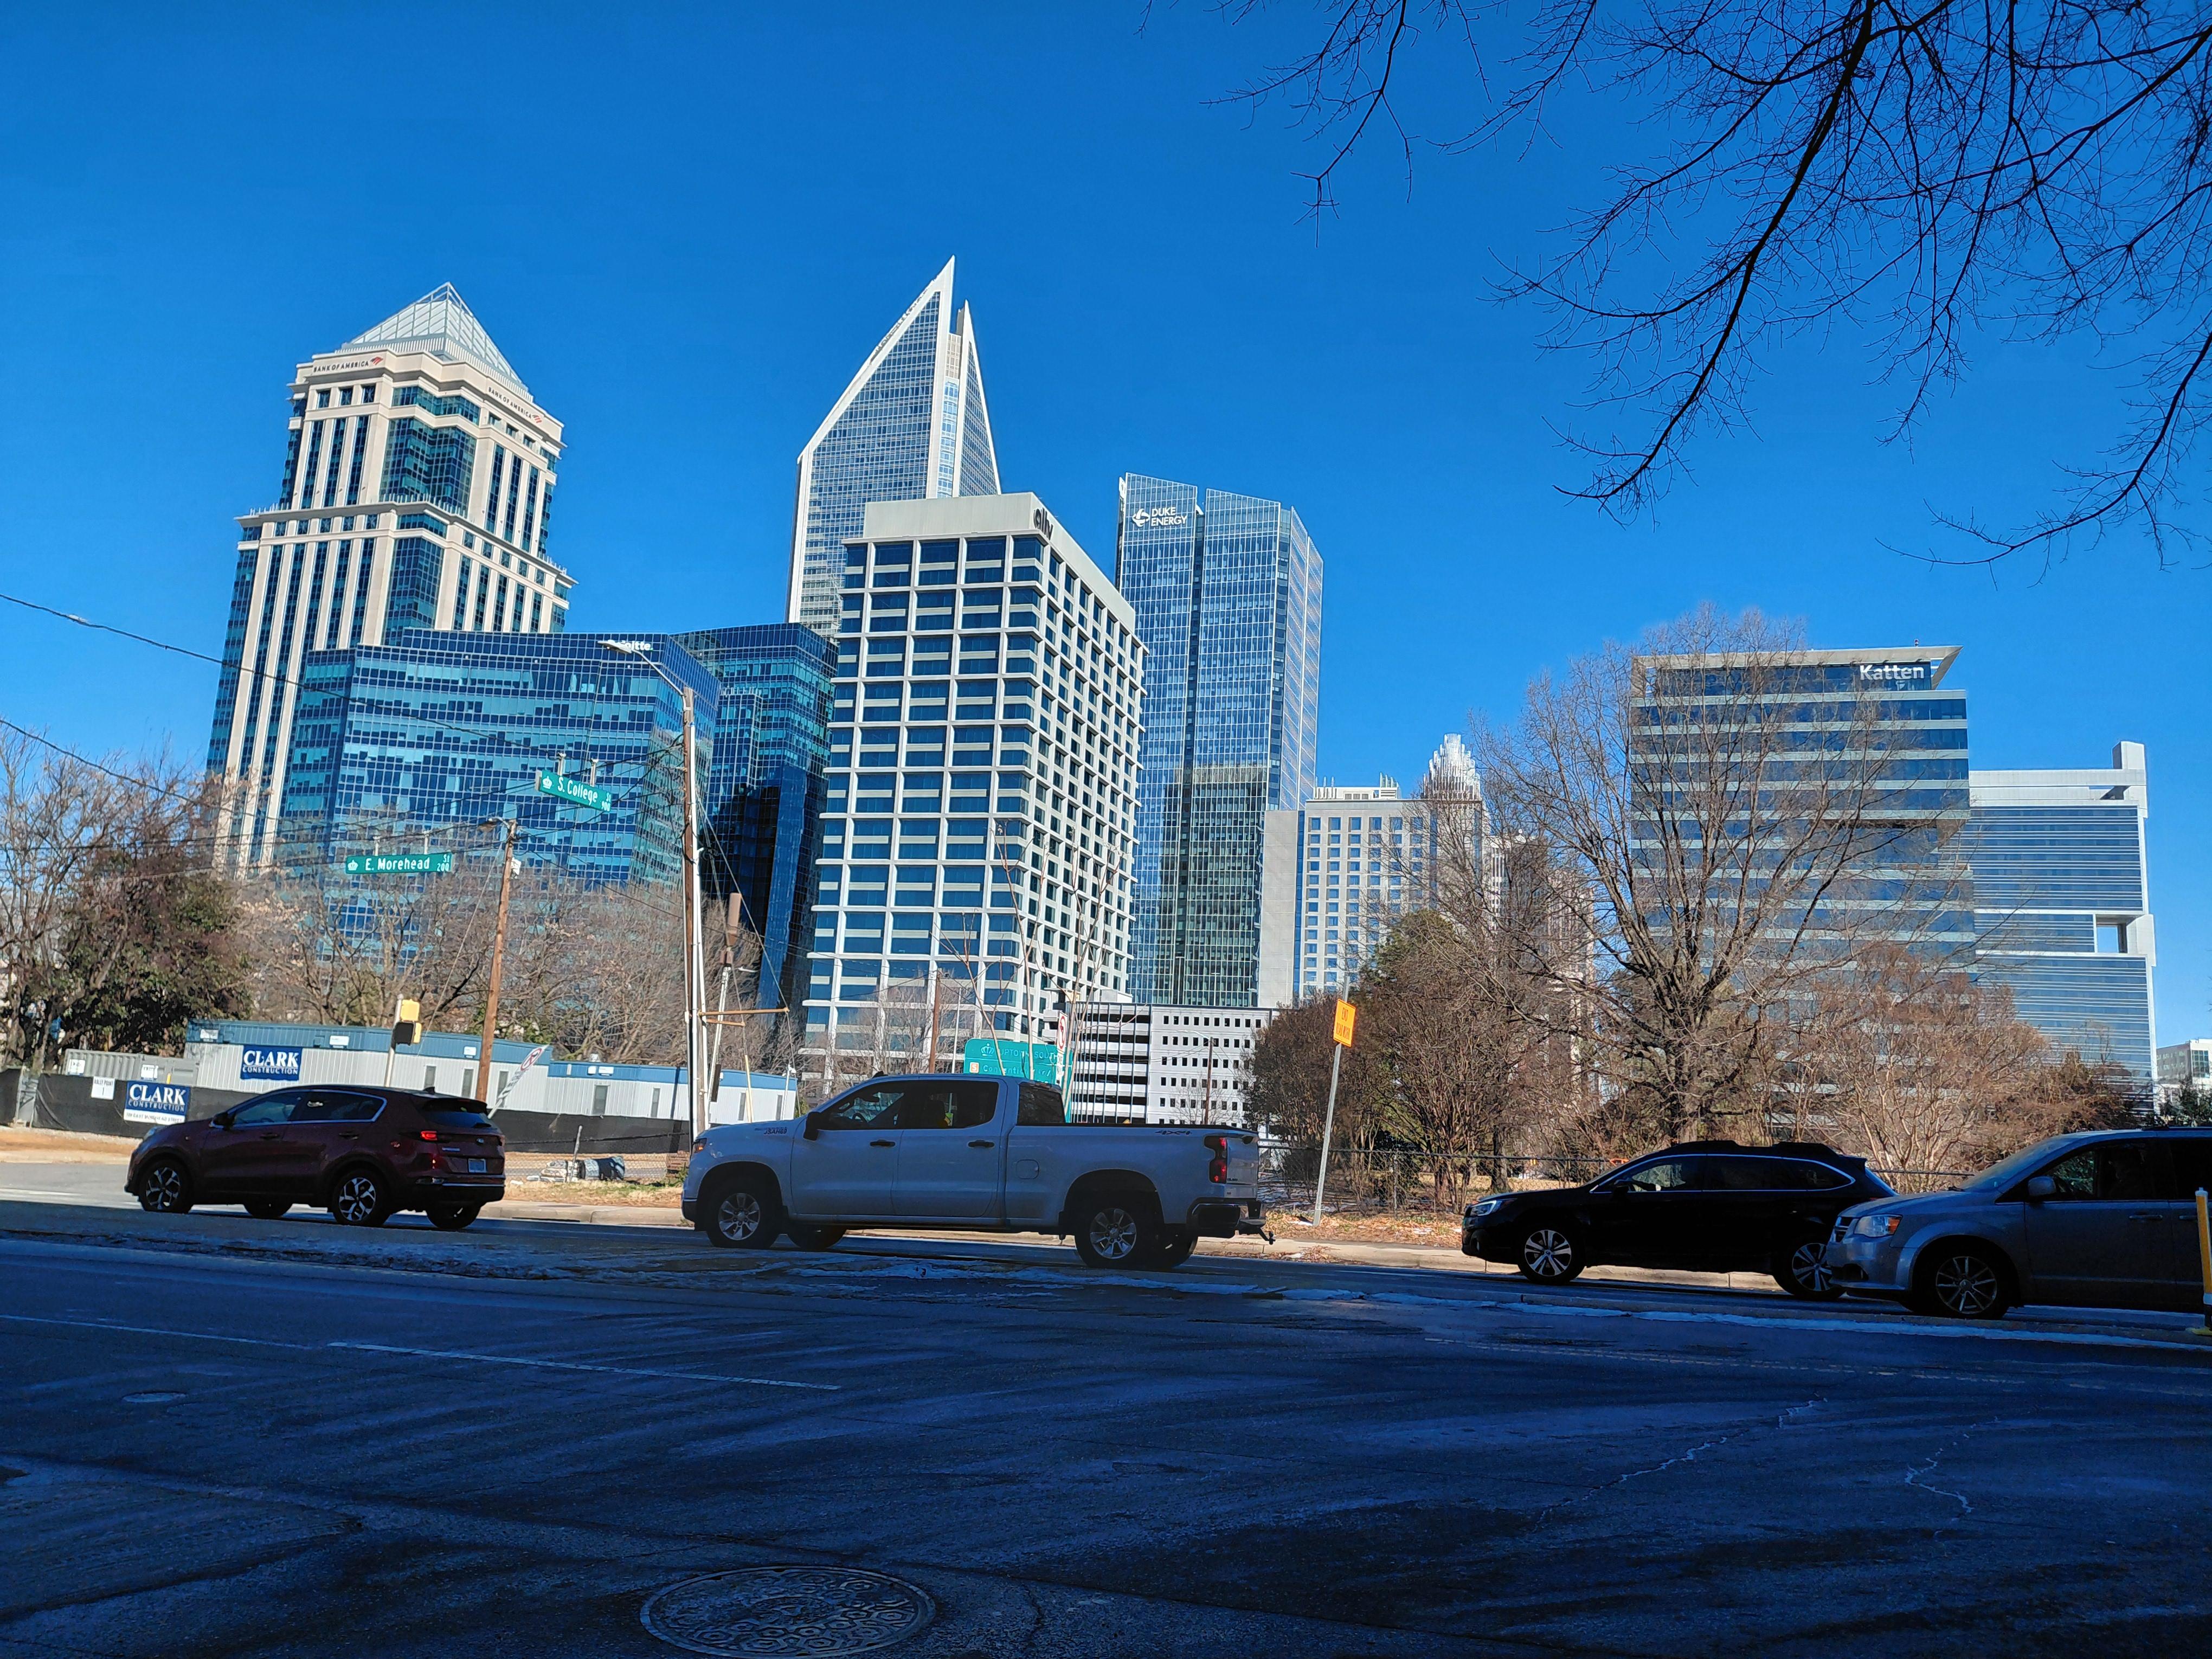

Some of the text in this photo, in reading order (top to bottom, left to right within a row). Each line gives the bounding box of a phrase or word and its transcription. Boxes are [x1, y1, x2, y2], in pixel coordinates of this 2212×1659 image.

[340, 361, 369, 369] AMERICA
[488, 387, 502, 400] BANK
[510, 402, 532, 419] AMERICA
[1151, 507, 1176, 517] DUKE
[1151, 515, 1187, 526] ENERGY
[1860, 665, 1924, 680] Katten
[557, 776, 611, 806] S. College St
[601, 800, 611, 812] 900
[365, 853, 450, 871] E. Morehead St
[436, 863, 449, 872] 200
[243, 1050, 299, 1068] CLARK
[242, 1066, 298, 1075] CONSTRUCTION
[130, 1084, 186, 1105] CLARK
[128, 1100, 185, 1113] CONSTRUCTION
